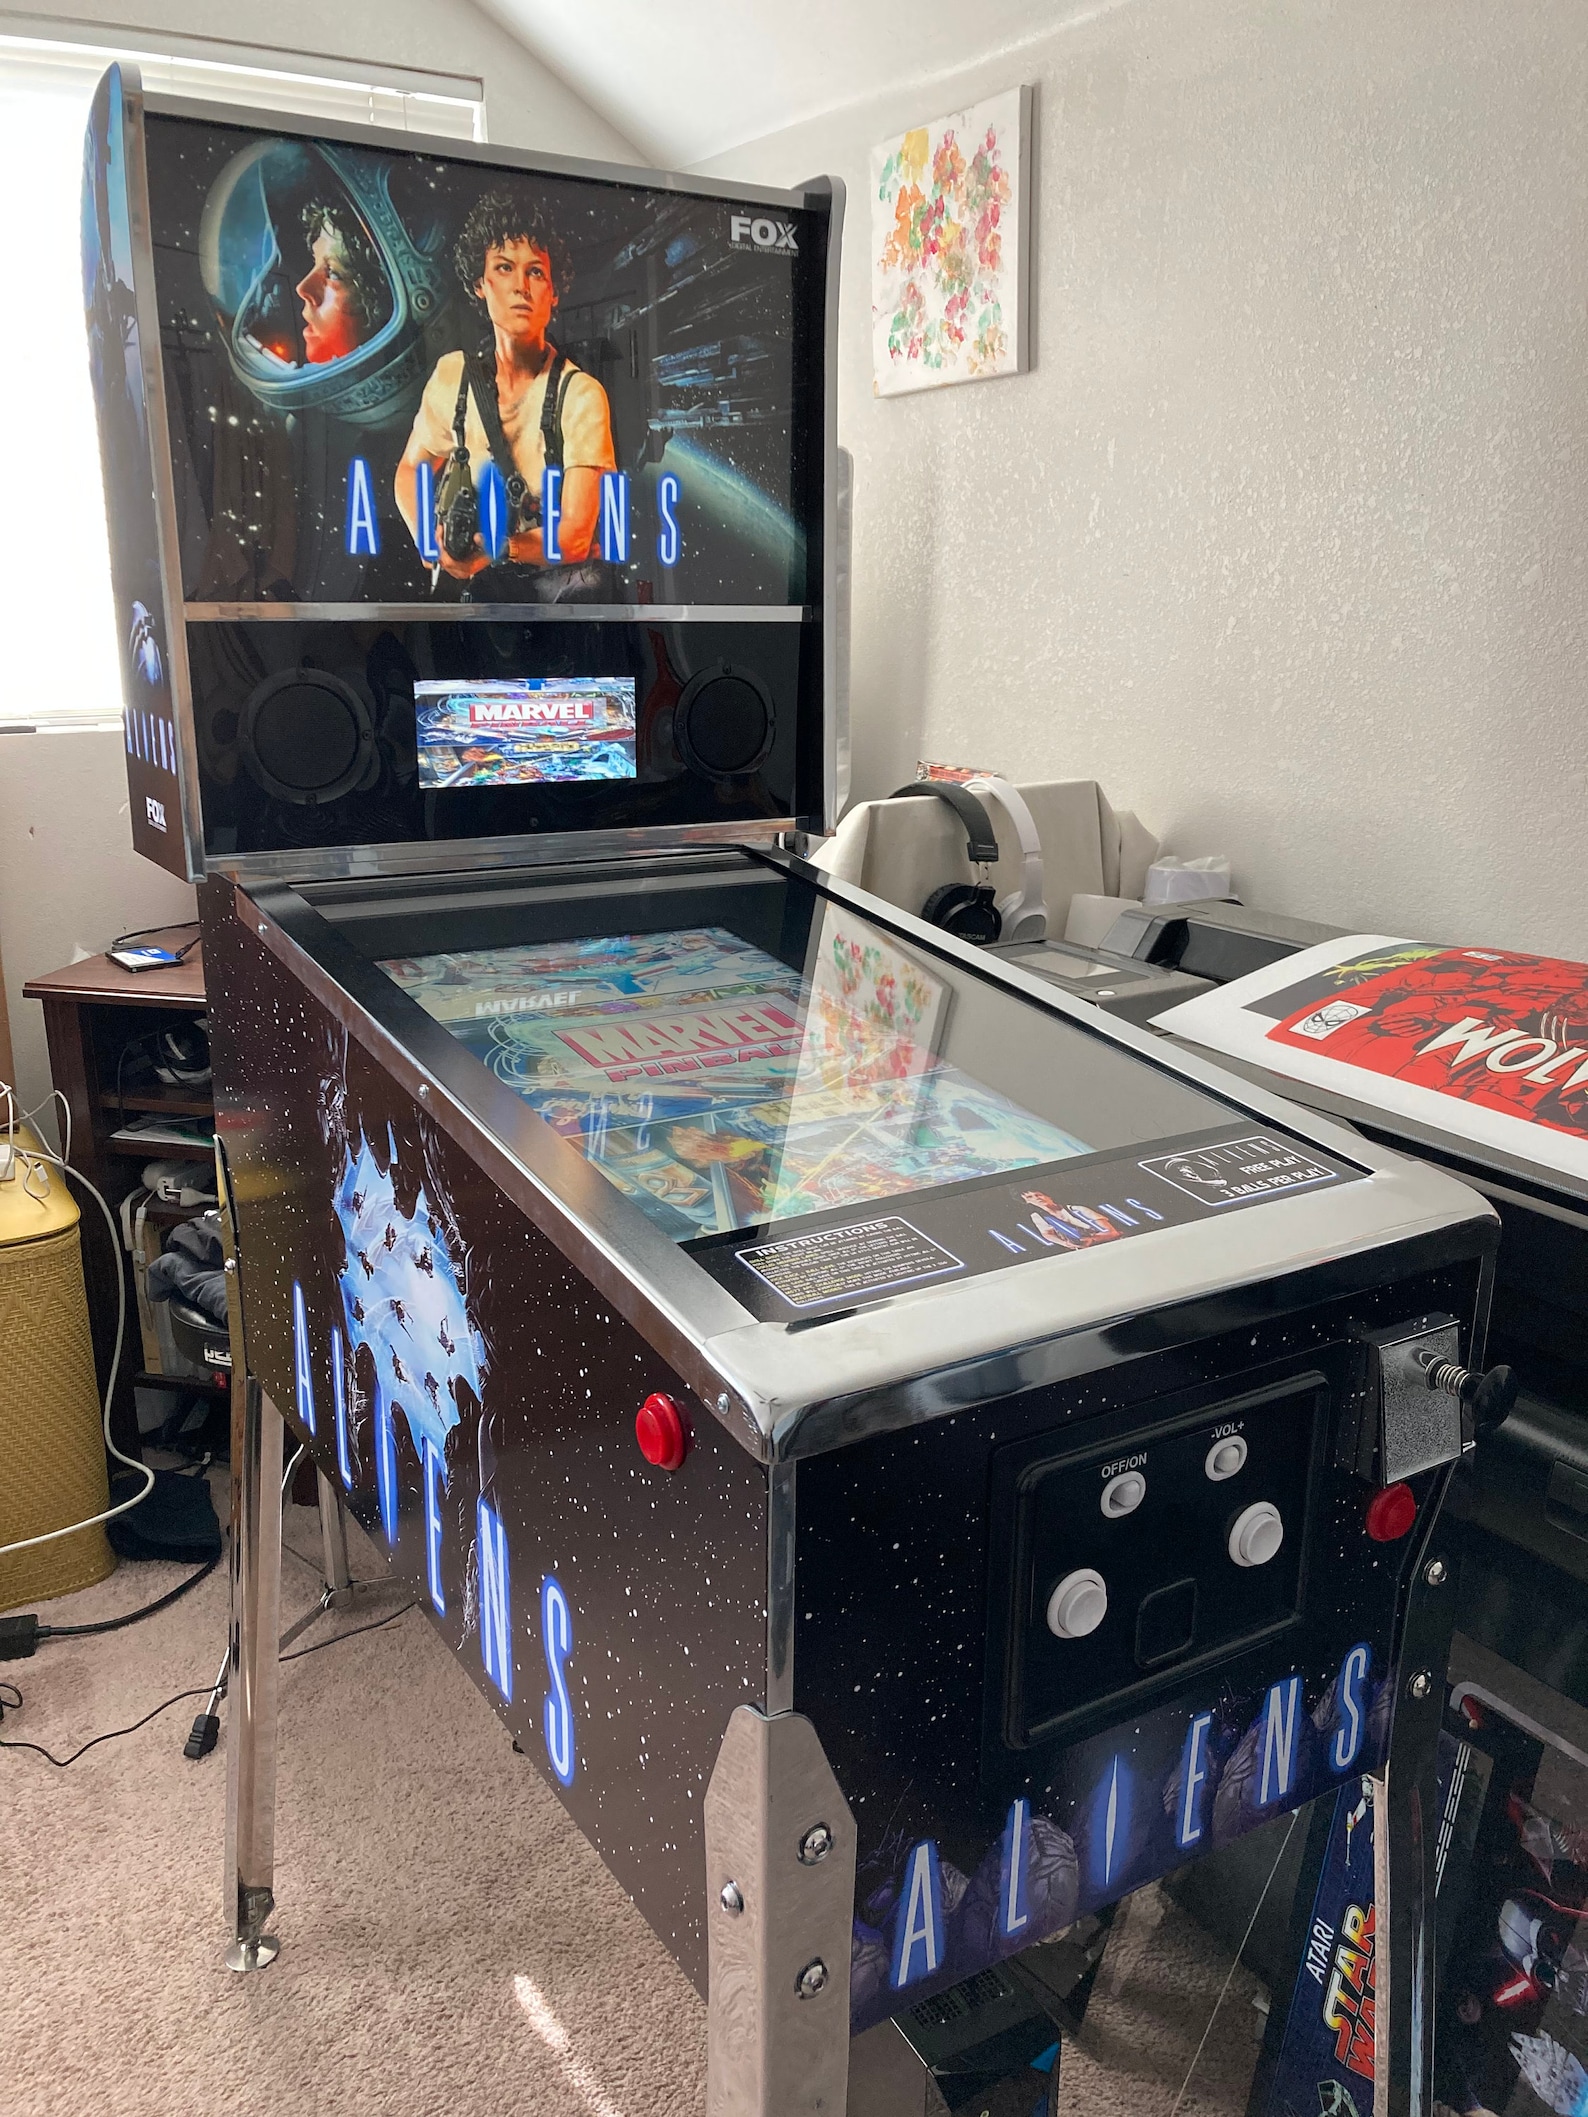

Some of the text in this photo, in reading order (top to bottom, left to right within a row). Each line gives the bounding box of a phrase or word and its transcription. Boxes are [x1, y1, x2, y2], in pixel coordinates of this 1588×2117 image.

[730, 215, 800, 250] FOX
[348, 458, 680, 566] ALIENS
[474, 702, 590, 721] MARVEL
[145, 796, 167, 827] FOX
[573, 1004, 804, 1065] MARVEL
[603, 1038, 812, 1084] PINBAL
[1219, 1166, 1326, 1198] 3 BALLS PER PLAY
[1238, 1154, 1303, 1176] FREE PLAY
[755, 1221, 890, 1257] INSTRUCTIONS
[1210, 1421, 1245, 1439] -VOL+
[1101, 1452, 1148, 1479] OFF/ON
[294, 1282, 571, 1784] ALIENS
[895, 1645, 1369, 1988] ALIENS
[1304, 1916, 1335, 1985] ATARI
[1322, 1903, 1375, 2066] STAR
